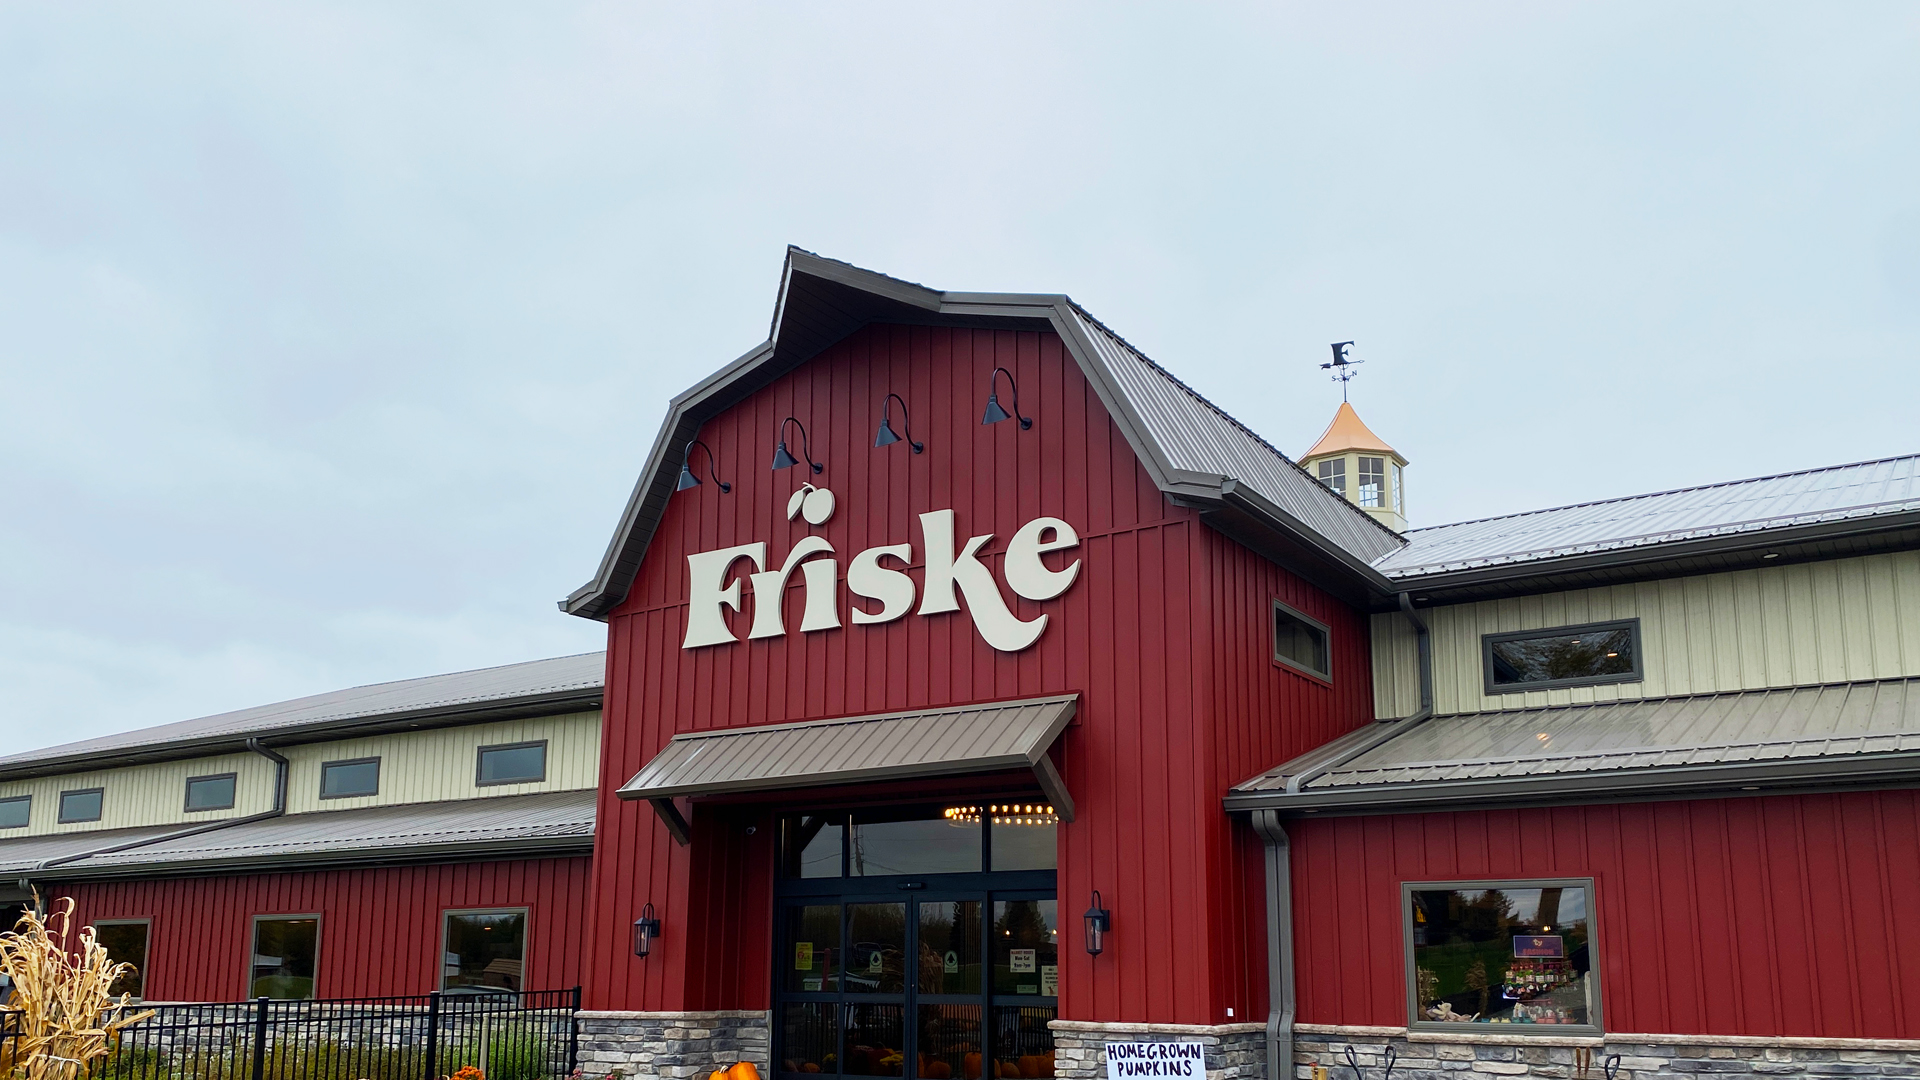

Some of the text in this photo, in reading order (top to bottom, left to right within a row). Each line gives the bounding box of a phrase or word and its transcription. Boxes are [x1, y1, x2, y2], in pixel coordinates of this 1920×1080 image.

[1330, 340, 1355, 366] F
[682, 483, 1081, 651] Friske
[1107, 1043, 1201, 1060] HOMEGROWN
[1117, 1060, 1192, 1077] PUMPKINS
